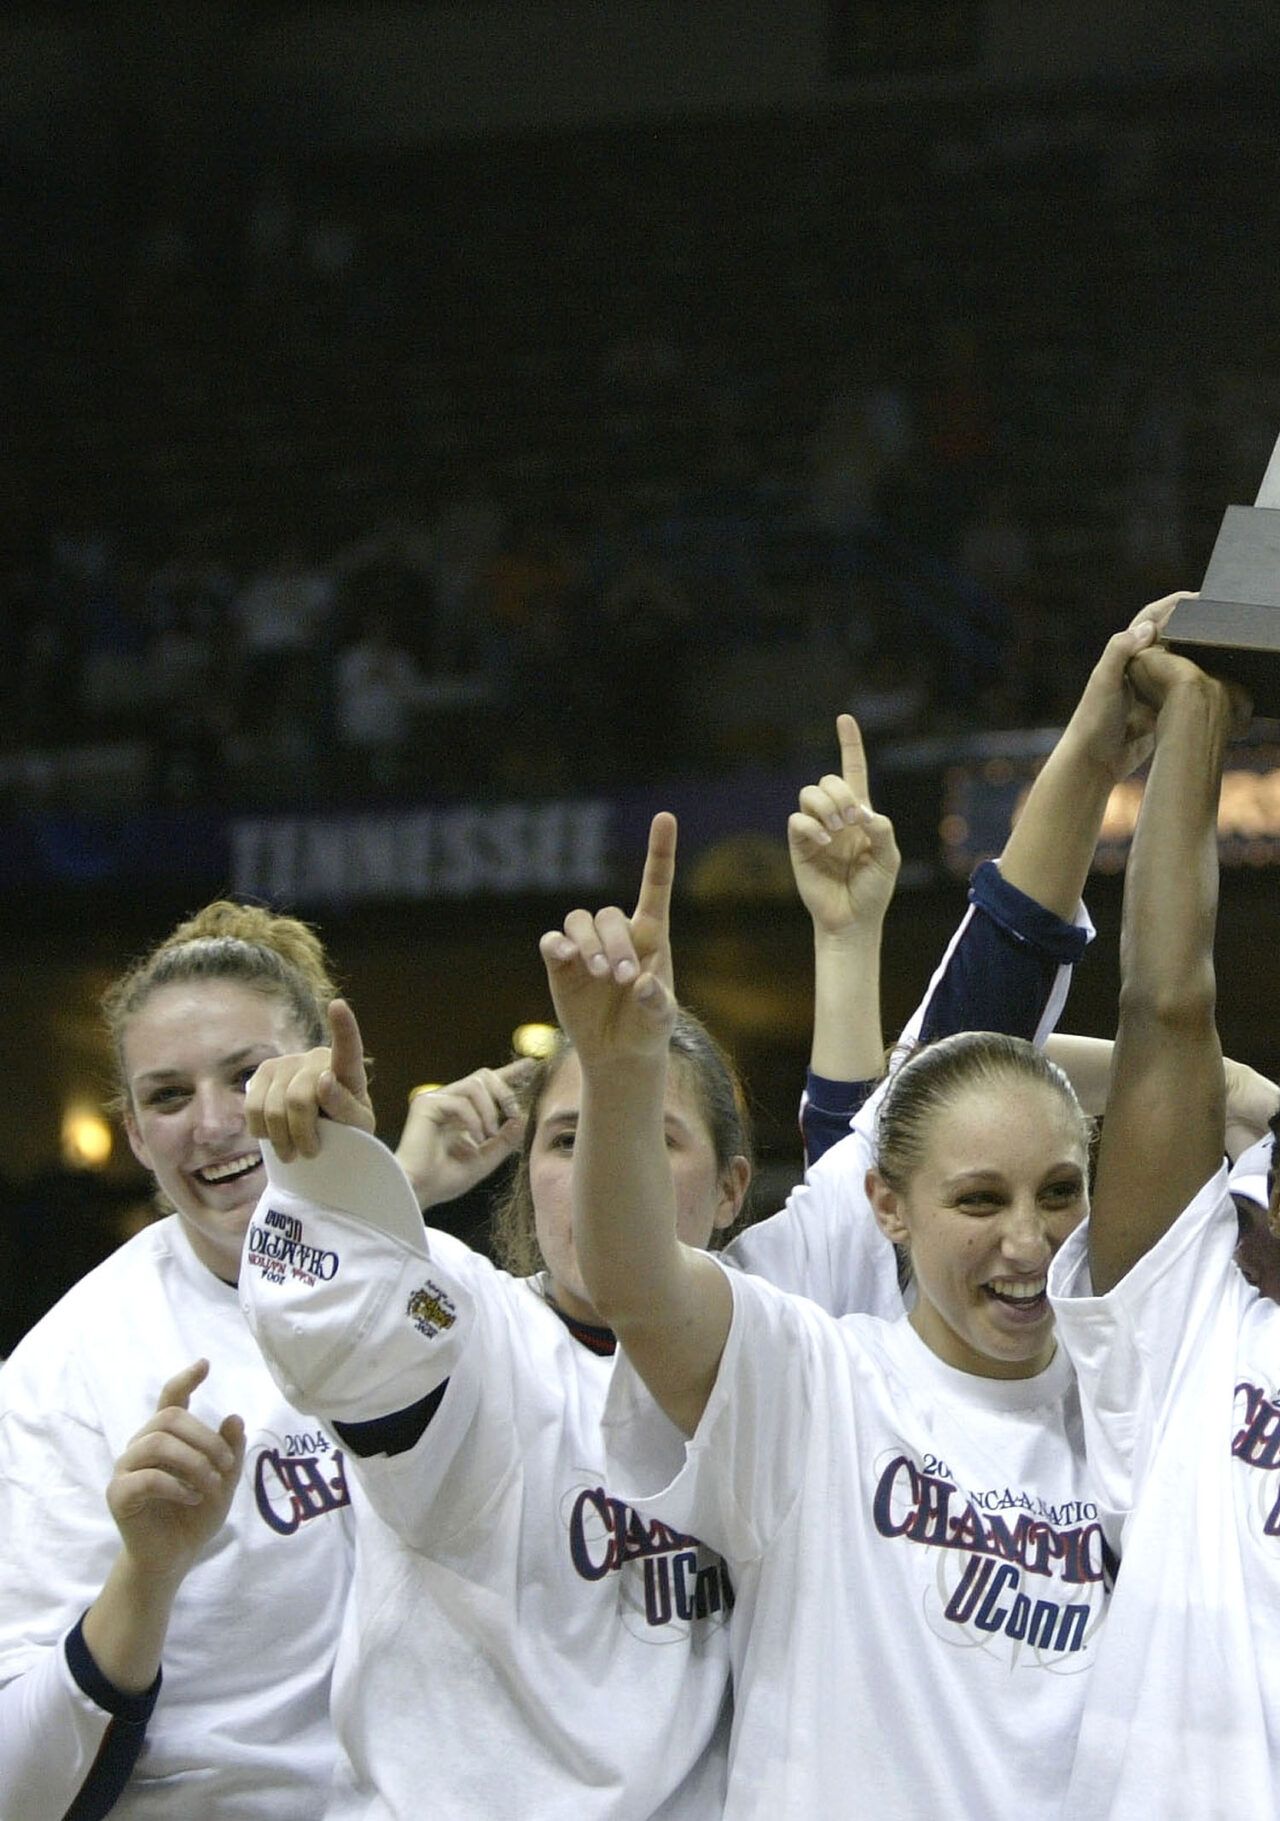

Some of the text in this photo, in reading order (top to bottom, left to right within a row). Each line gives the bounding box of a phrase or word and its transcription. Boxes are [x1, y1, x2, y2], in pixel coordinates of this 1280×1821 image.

[232, 801, 611, 902] TENNESSEE
[264, 1209, 303, 1243] UConn
[285, 1430, 330, 1457] 2004
[967, 1487, 1037, 1511] NCAA
[943, 1554, 1091, 1652] UConn
